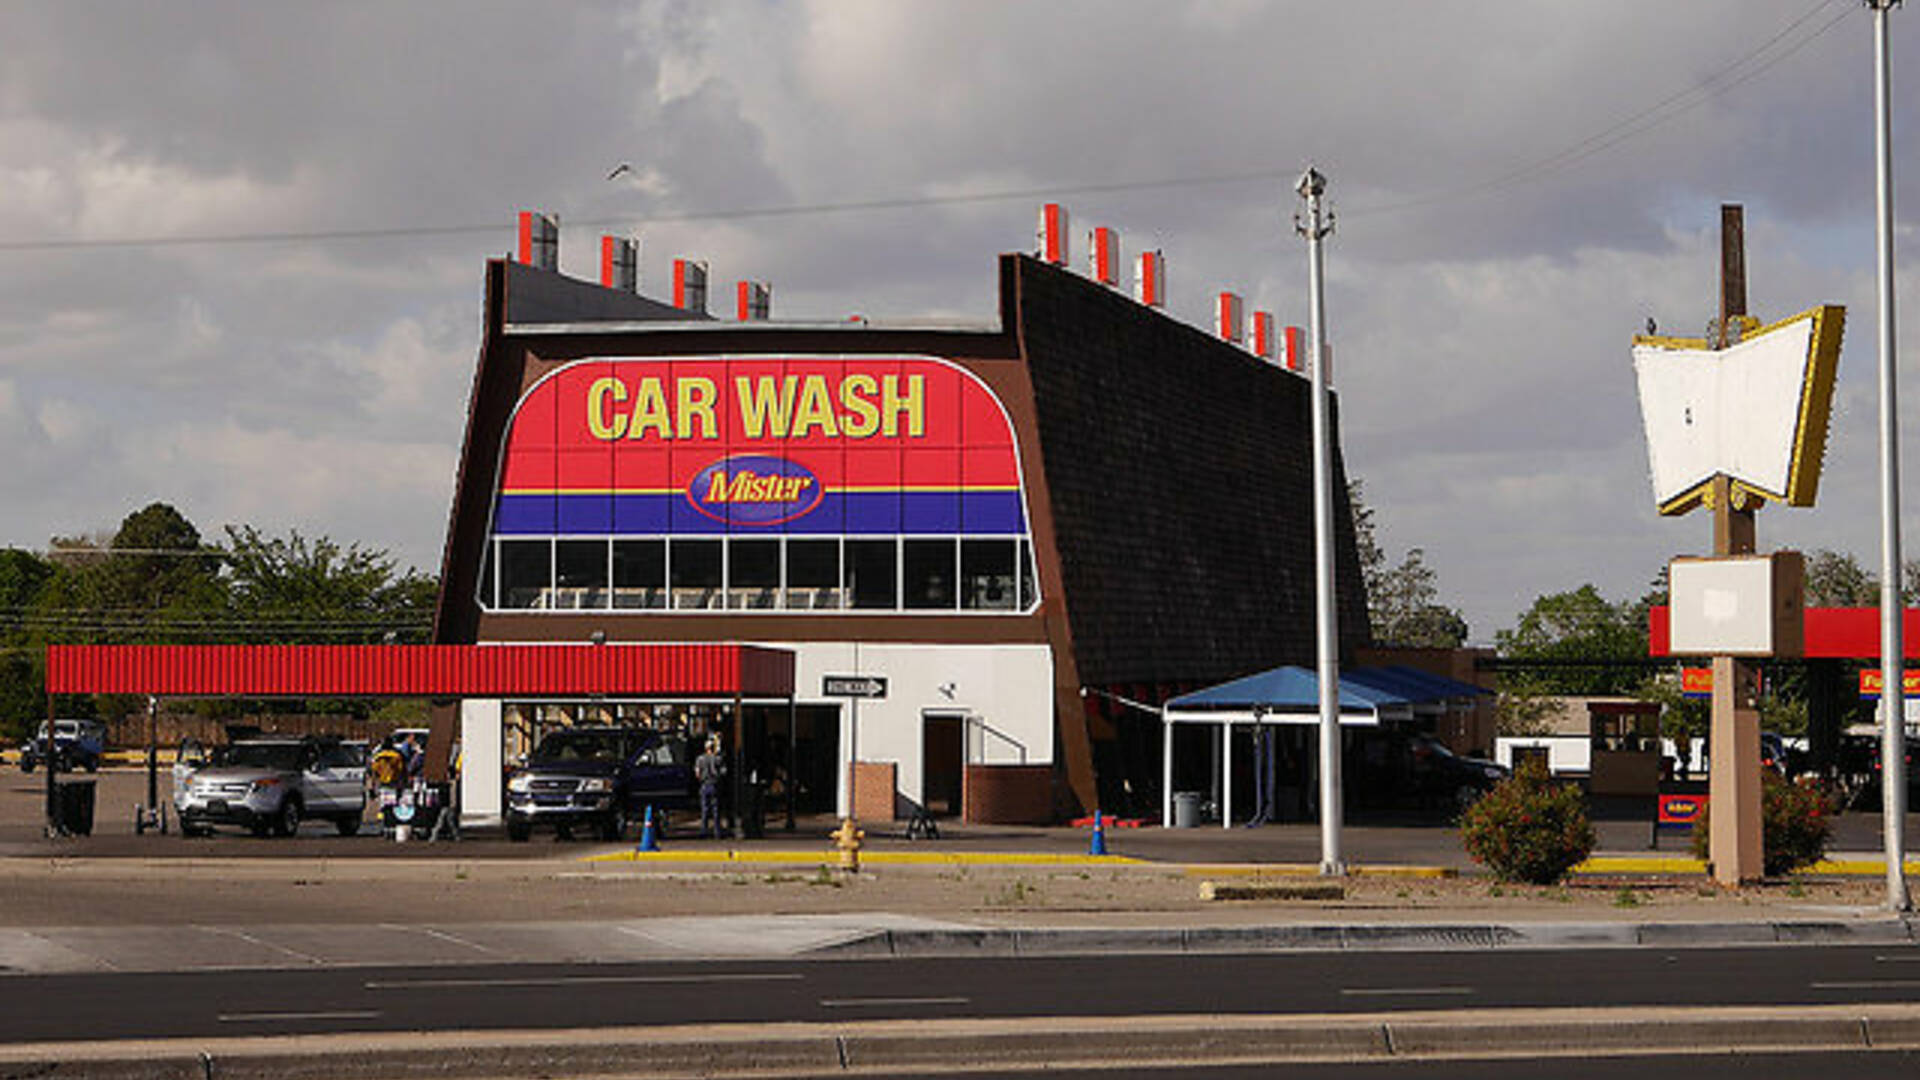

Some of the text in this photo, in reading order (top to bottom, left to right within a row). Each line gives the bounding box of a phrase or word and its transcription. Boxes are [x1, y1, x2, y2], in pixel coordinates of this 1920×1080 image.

[588, 374, 925, 440] CAR WASH
[703, 470, 812, 503] Mister
